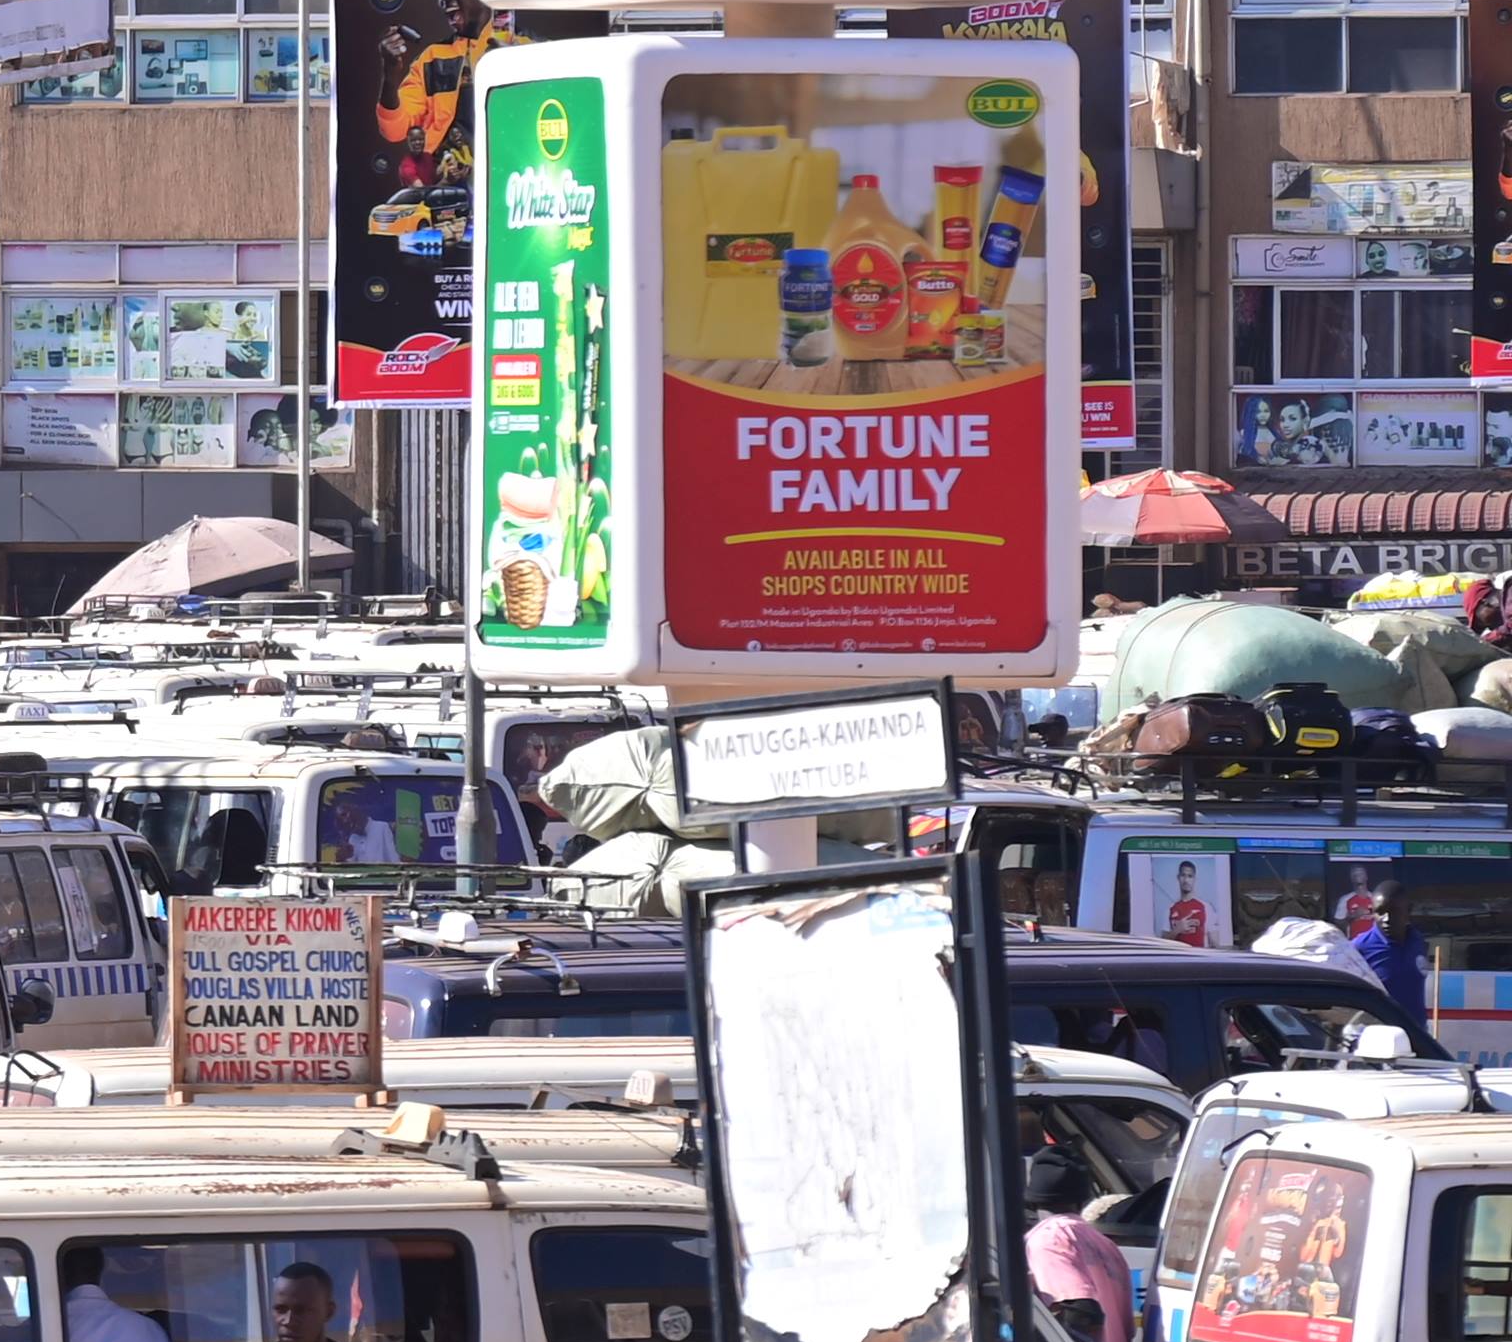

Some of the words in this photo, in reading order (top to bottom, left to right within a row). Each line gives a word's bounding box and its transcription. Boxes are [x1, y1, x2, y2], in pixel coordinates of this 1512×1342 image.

[737, 415, 991, 463] FORTUNE
[770, 469, 961, 513] FAMILY
[783, 549, 885, 571] AVAILABLE
[891, 549, 909, 569] IN
[915, 548, 947, 569] ALL
[1237, 545, 1363, 575] BETA
[762, 576, 826, 596] SHOPS
[830, 574, 919, 595] COUNTRY
[921, 574, 969, 594] WIDE
[705, 711, 928, 762] MATUGGA-KAWANDA
[770, 761, 870, 795] WATTUBA
[184, 907, 278, 932] MAKERERE
[285, 907, 343, 931] KIKONI
[245, 934, 292, 946] VIA
[228, 950, 300, 972] GOSPEL
[265, 977, 314, 1000] VILLA
[184, 1005, 284, 1027] CANAAN
[296, 1005, 359, 1027] LAND
[256, 1032, 282, 1055] OF
[289, 1032, 369, 1056] PRAYER
[199, 1060, 352, 1082] MINISTRIES
